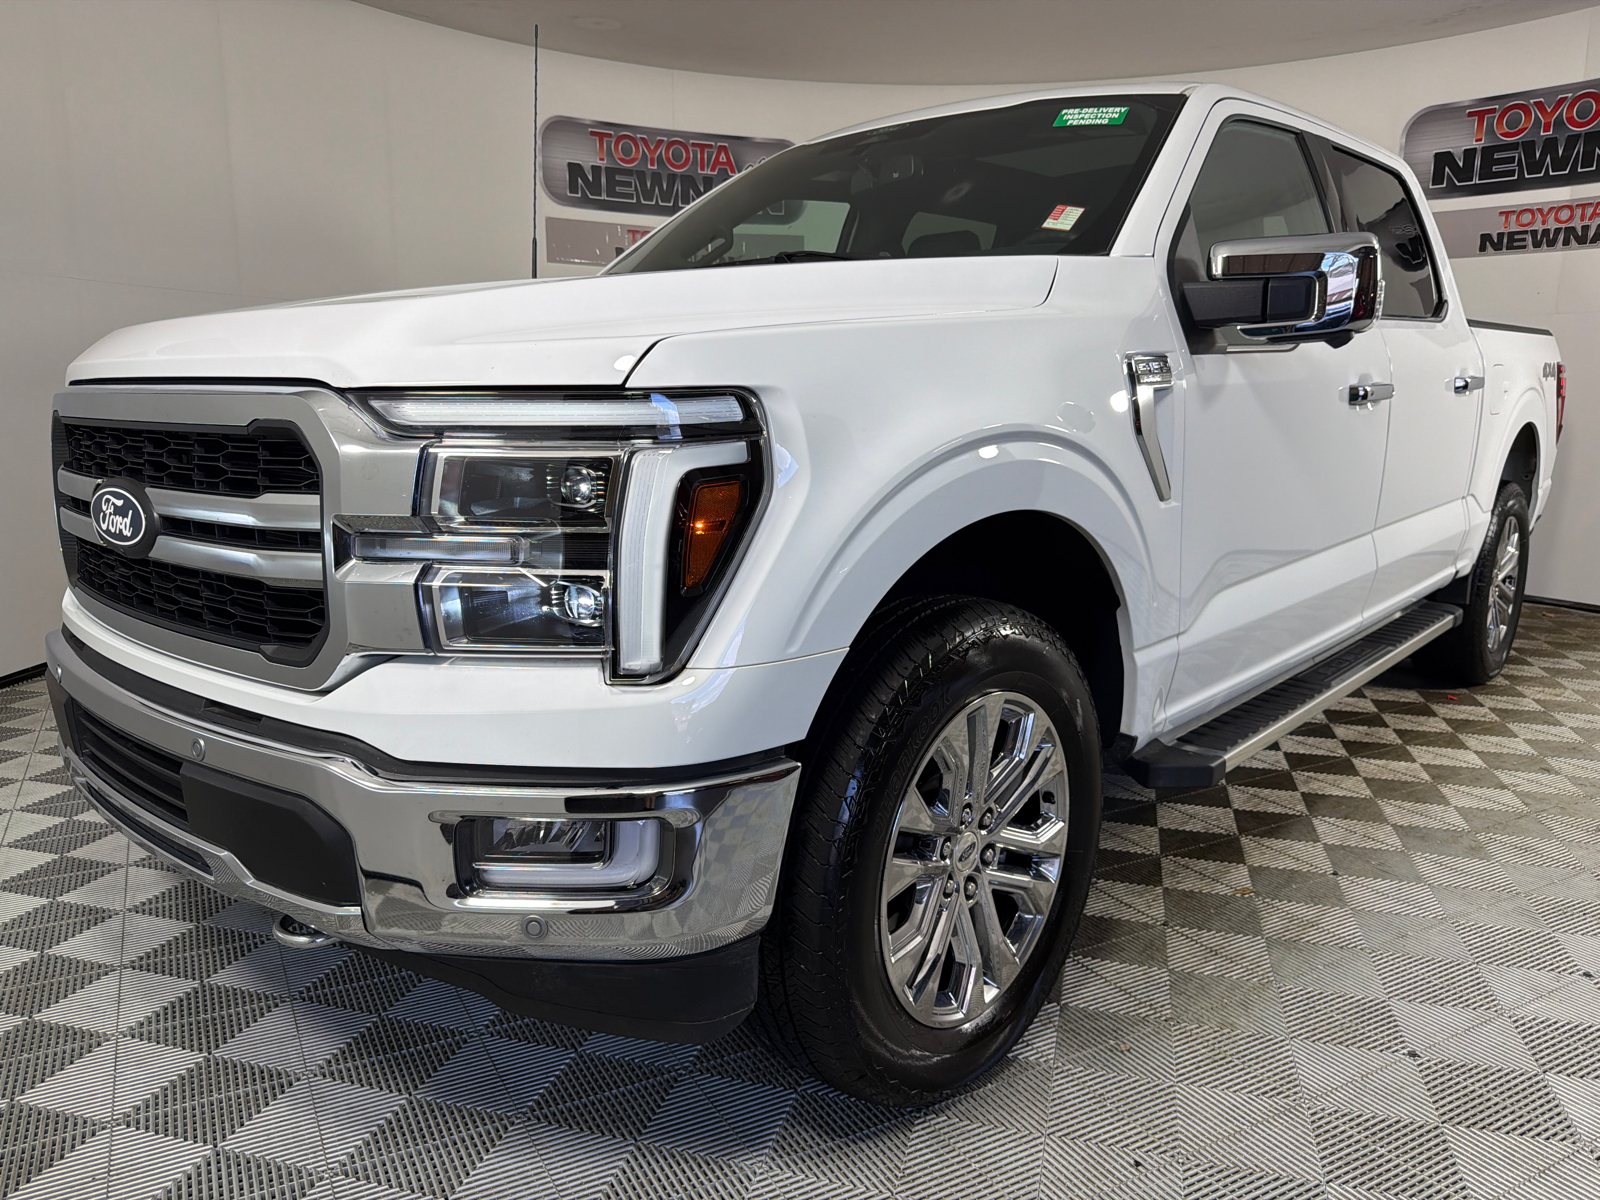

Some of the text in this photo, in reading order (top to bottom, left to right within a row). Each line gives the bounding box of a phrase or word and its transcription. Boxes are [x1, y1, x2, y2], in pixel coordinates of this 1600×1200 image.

[1062, 107, 1127, 115] PRE-DELIVERY
[589, 130, 737, 175] TOYOTA
[567, 162, 730, 207] NEWN
[100, 494, 133, 537] Ford
